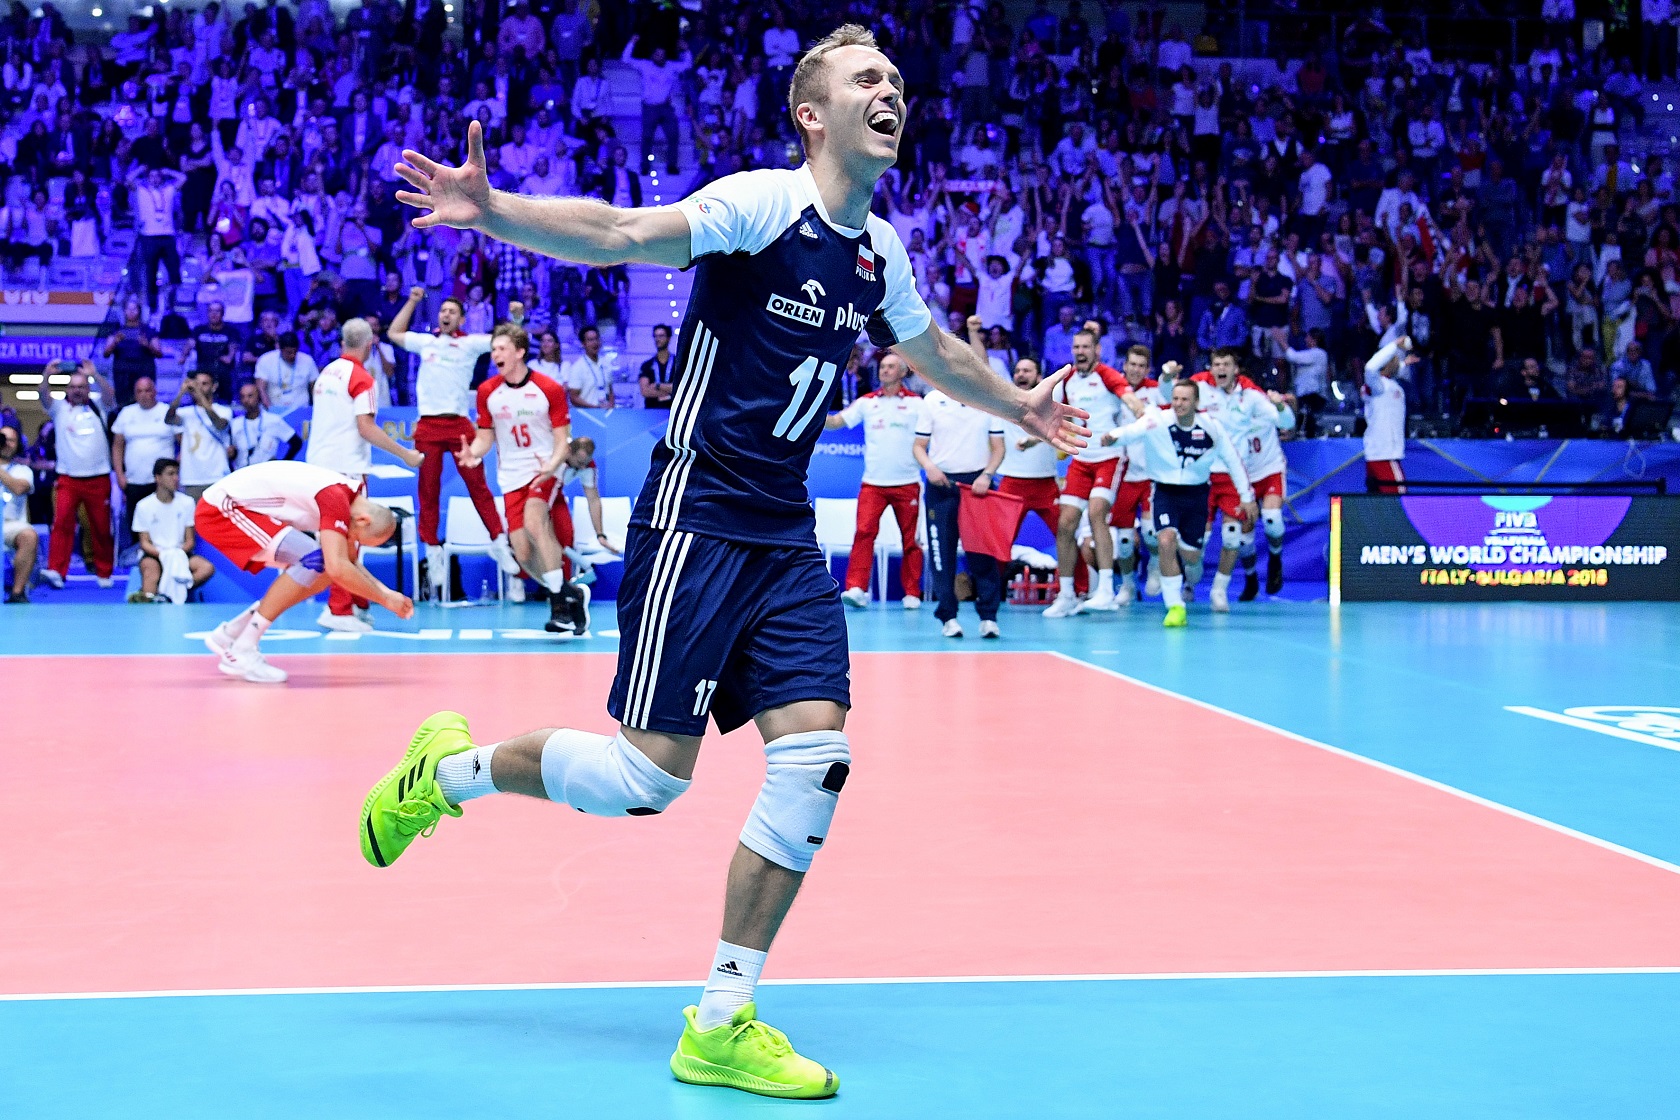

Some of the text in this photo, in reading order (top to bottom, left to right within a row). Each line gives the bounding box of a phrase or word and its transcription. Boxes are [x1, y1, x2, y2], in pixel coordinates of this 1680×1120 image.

[771, 298, 822, 324] ORLEN
[20, 342, 62, 359] ATLETI
[772, 355, 837, 442] 17
[511, 423, 532, 448] 15
[1495, 511, 1538, 528] FIVB
[1360, 545, 1668, 565] MEN'S WORLD CHAMPIONSHIP
[1567, 568, 1609, 587] 2018
[692, 678, 718, 716] 17
[716, 967, 743, 977] adidas
